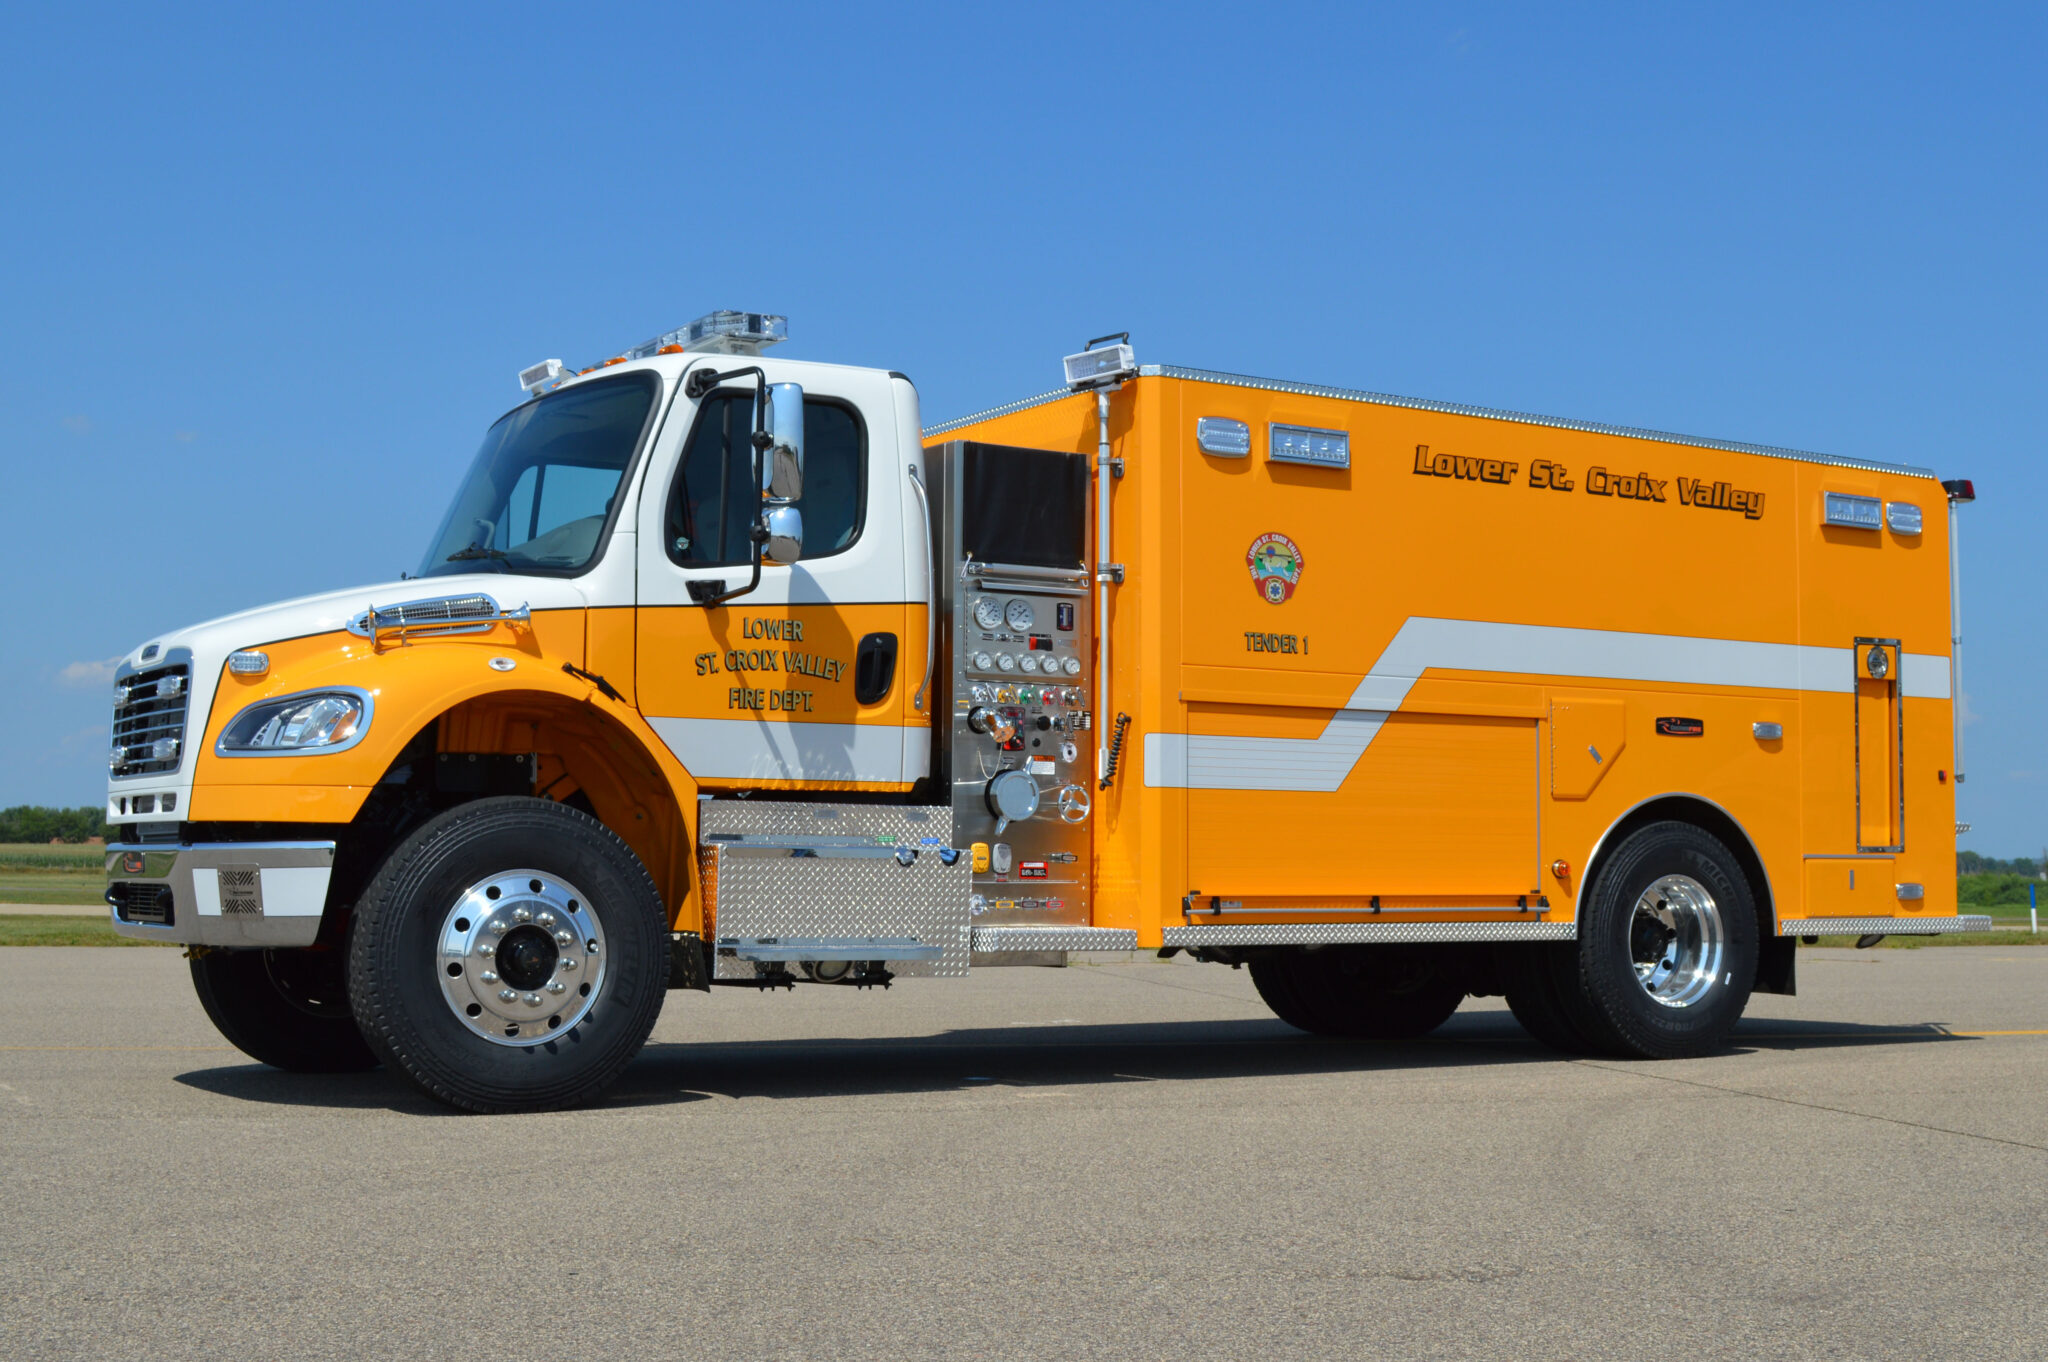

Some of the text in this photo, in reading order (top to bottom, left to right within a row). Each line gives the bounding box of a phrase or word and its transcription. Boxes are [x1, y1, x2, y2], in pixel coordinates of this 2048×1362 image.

[1412, 444, 1766, 520] Lower St. Croix Valley
[1248, 539, 1262, 559] LOWER
[1271, 533, 1288, 545] CROIX
[1287, 541, 1301, 563] VALLEY
[1249, 565, 1259, 580] FIRE
[743, 617, 804, 641] LOWER
[1244, 632, 1309, 655] TENDER 1
[695, 649, 848, 682] ST. CROIX VALLEY
[729, 688, 814, 712] FIRE DEPT.
